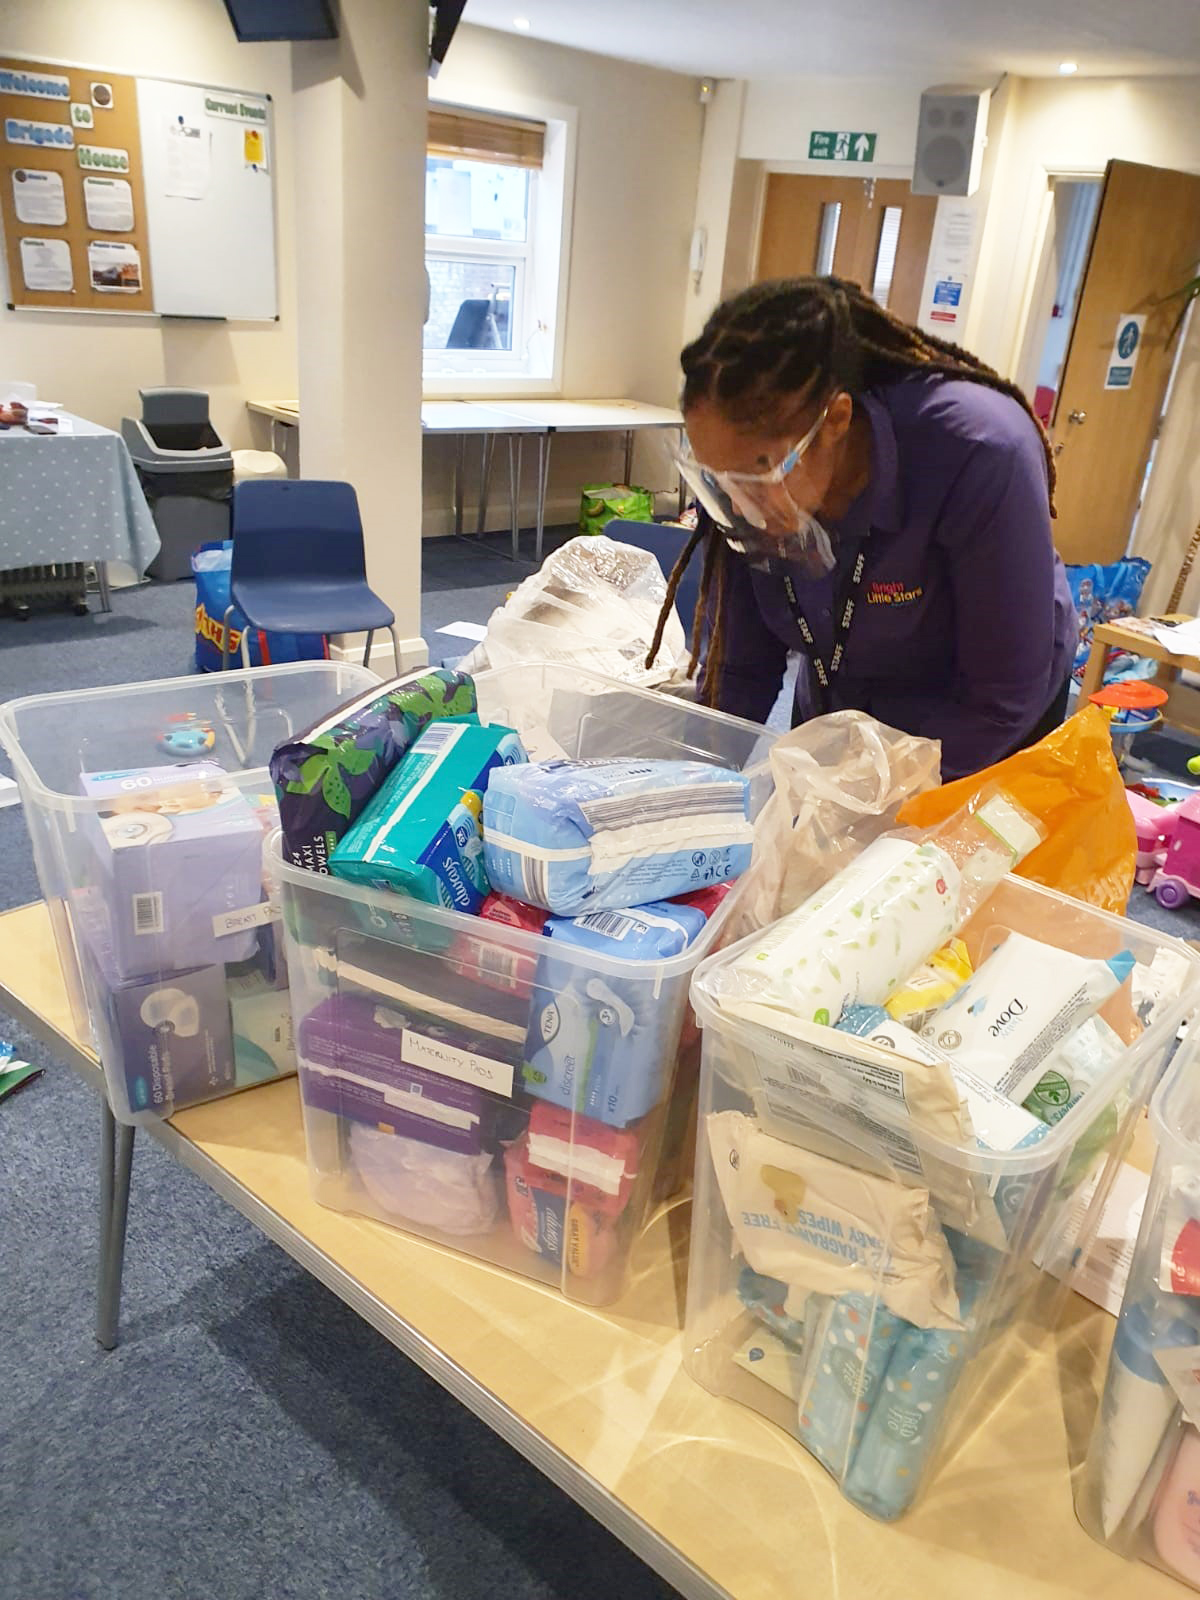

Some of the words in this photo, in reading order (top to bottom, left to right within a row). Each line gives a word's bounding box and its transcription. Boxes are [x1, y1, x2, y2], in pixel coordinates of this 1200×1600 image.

[74, 106, 91, 122] to
[812, 147, 828, 157] exit
[814, 134, 830, 145] Fire
[79, 148, 128, 169] House
[852, 553, 865, 584] STAFF
[867, 592, 891, 604] Little
[894, 587, 923, 602] Stars
[841, 599, 855, 629] STAFF
[798, 616, 814, 644] STAFF
[830, 643, 844, 672] STAFF
[813, 657, 829, 687] STAFF
[120, 776, 153, 790] 60
[292, 852, 302, 866] 24
[313, 835, 328, 877] OWELS
[442, 856, 471, 907] always
[544, 1010, 555, 1034] TENA
[988, 999, 1028, 1038] Dove
[149, 1044, 162, 1091] Disposable
[409, 1037, 464, 1067] MATERNITY
[470, 1059, 494, 1080] PADS
[559, 1055, 576, 1096] discreet
[153, 1090, 164, 1104] 60
[543, 1206, 562, 1252] always
[741, 1211, 781, 1231] FREE
[798, 1209, 844, 1237] WIPES
